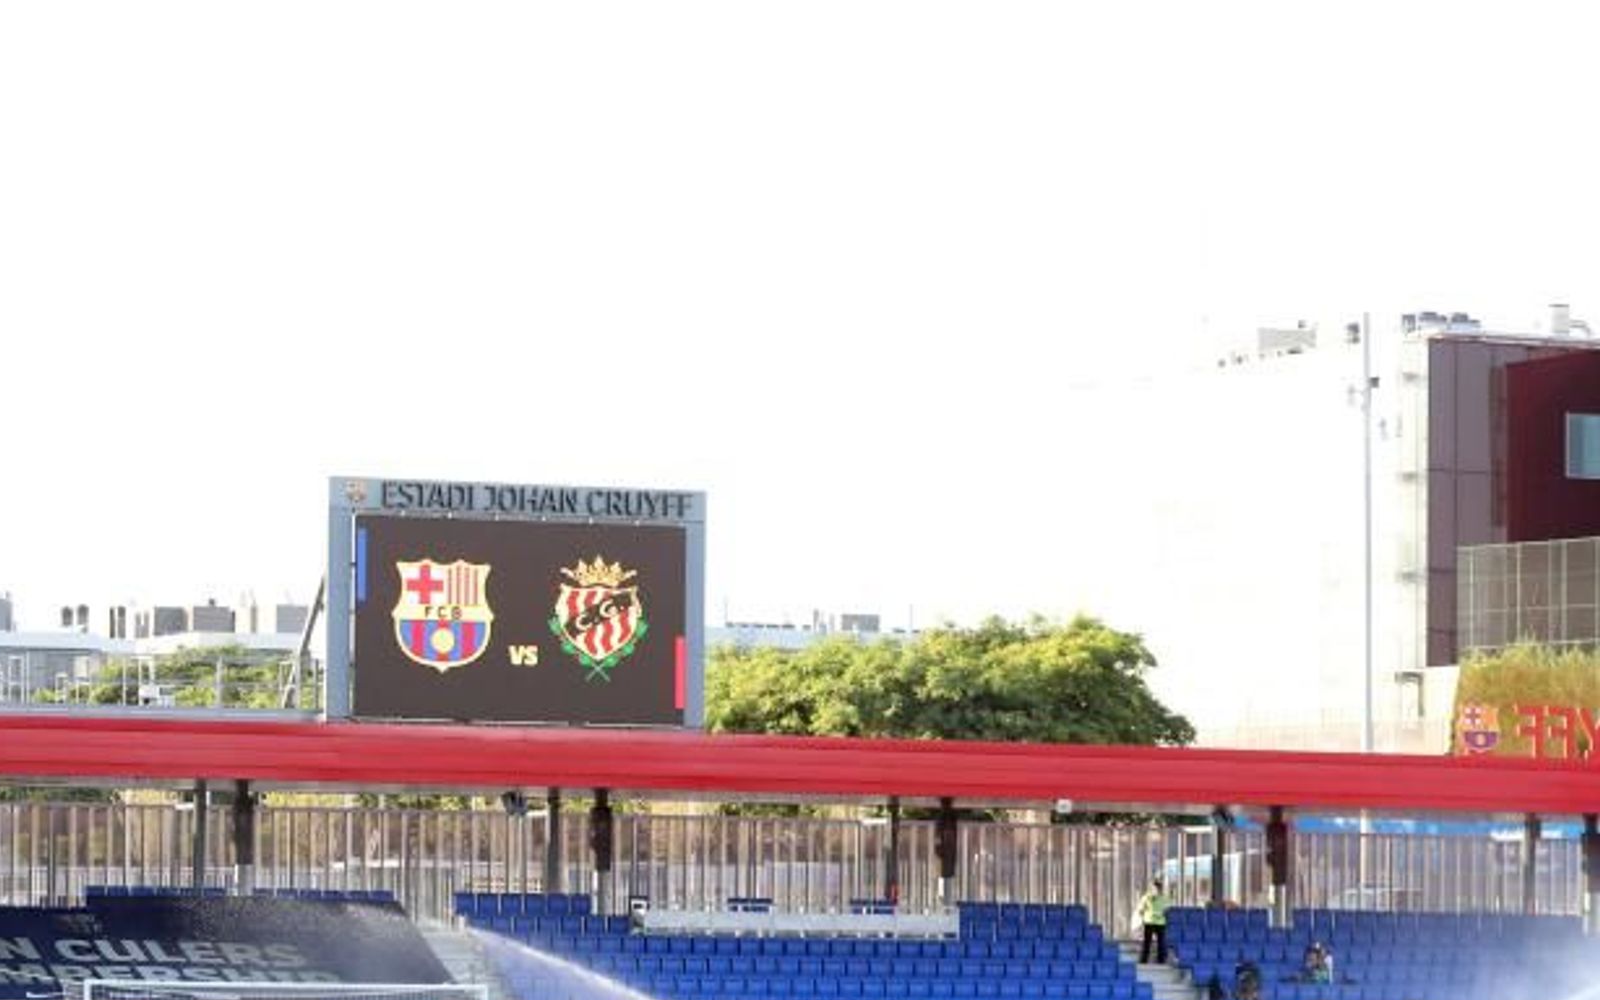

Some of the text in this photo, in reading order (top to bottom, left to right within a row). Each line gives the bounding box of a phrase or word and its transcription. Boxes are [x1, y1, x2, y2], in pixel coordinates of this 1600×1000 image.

[381, 480, 694, 518] ESTADI JOHAN CRUYFF
[53, 939, 307, 966] CULERS
